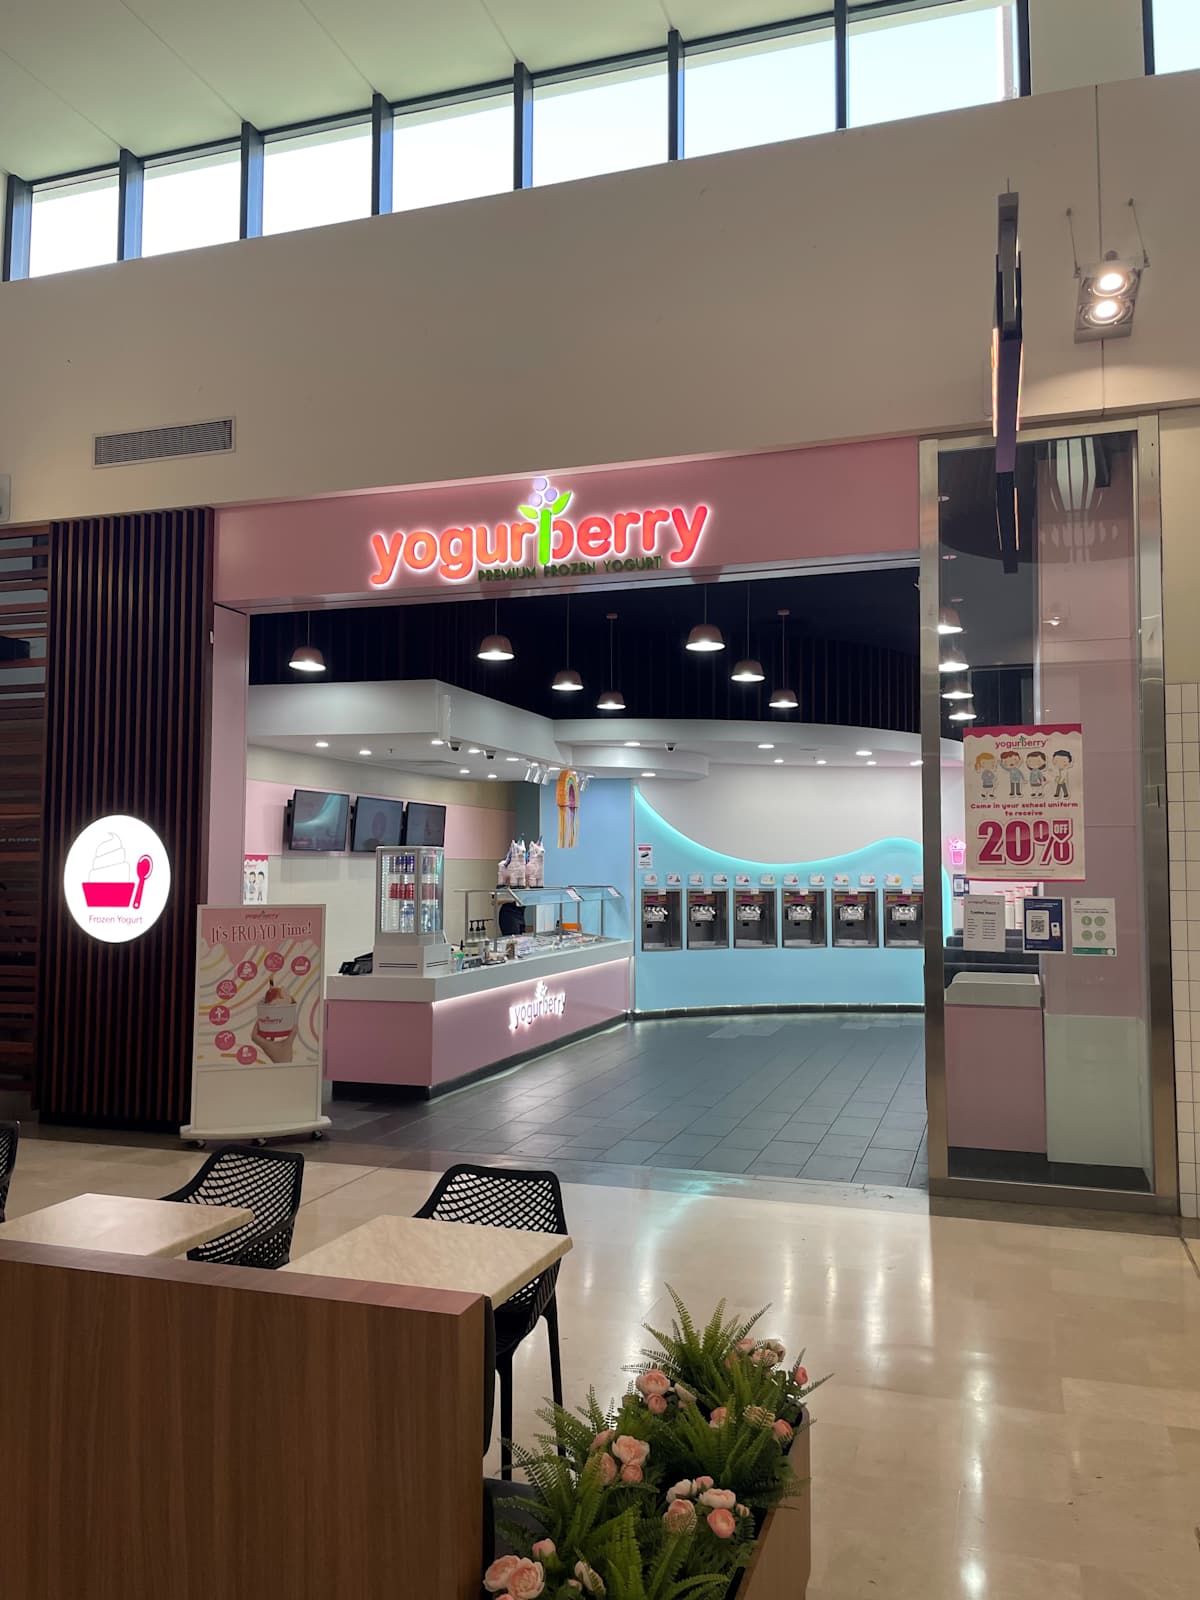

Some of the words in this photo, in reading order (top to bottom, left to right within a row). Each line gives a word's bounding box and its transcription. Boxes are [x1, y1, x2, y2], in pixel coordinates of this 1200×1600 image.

[370, 505, 708, 585] yogurberry
[478, 565, 536, 582] PREMIUM
[543, 560, 597, 578] FROZEN
[603, 555, 662, 573] YOGURT
[994, 737, 1047, 750] yogurberry
[1054, 824, 1069, 834] OFF
[978, 819, 1072, 864] 20%
[89, 914, 115, 924] Frozen
[117, 914, 143, 925] Yogurt
[212, 925, 228, 943] It's
[280, 921, 311, 939] Time!
